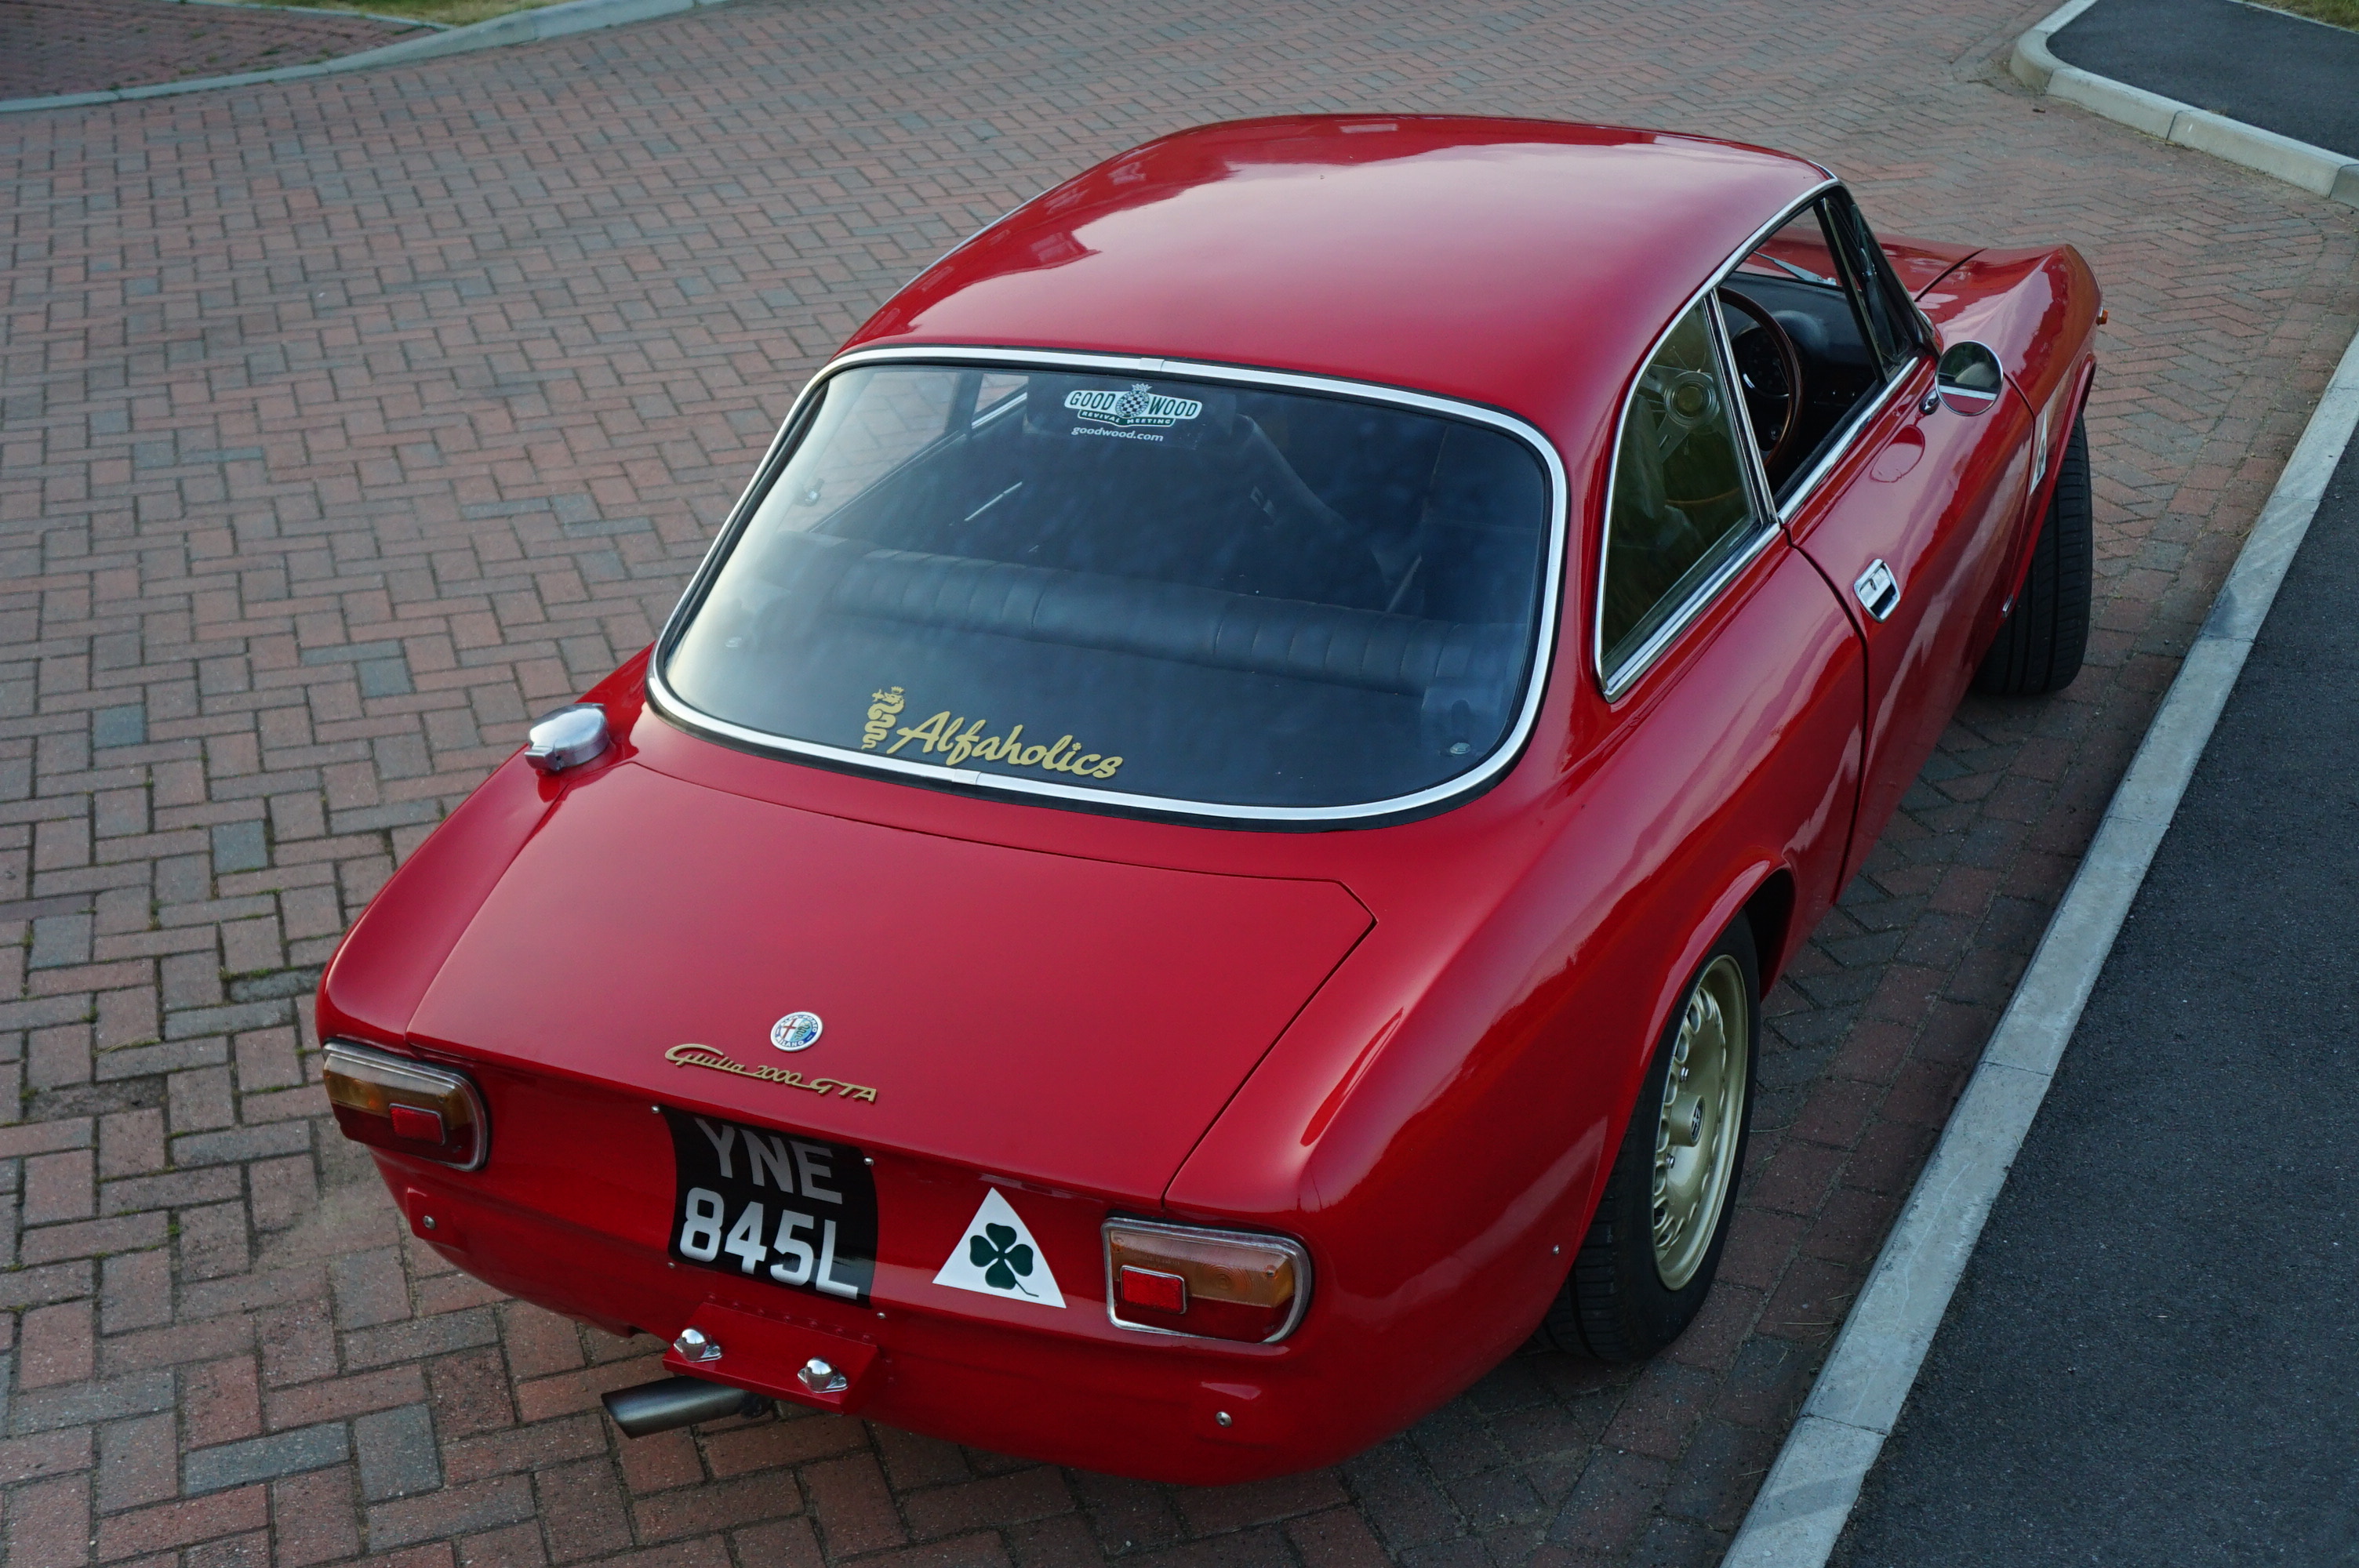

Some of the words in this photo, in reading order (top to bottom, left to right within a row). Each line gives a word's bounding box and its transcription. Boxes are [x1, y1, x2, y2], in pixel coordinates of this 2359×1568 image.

[1070, 392, 1116, 410] GOOD
[1148, 396, 1198, 417] WOOD
[1081, 411, 1120, 423] REVIVAL
[1071, 426, 1164, 442] goodwood.com
[886, 711, 1123, 779] Alfaholics
[752, 1065, 803, 1086] 2000
[809, 1078, 877, 1103] GTA
[694, 1116, 843, 1205] YNE
[680, 1187, 859, 1300] 845L
